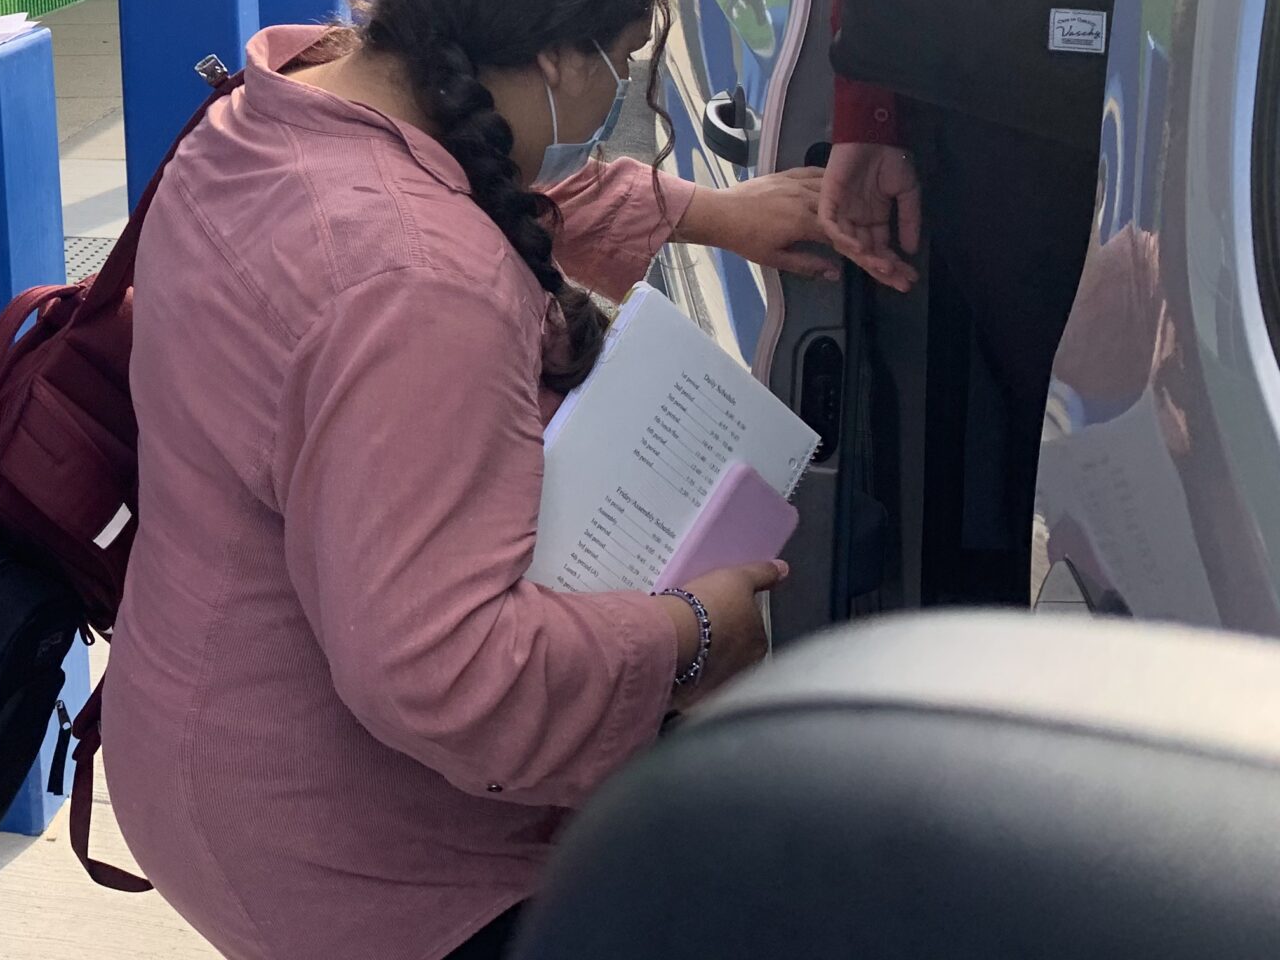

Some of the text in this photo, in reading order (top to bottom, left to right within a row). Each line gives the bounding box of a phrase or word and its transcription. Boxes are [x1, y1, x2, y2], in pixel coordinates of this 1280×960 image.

[704, 374, 737, 406] Daily Schedule
[610, 501, 625, 514] period
[616, 486, 677, 539] Friday Assembly Schedule
[598, 507, 618, 526] Assembly
[596, 524, 612, 537] period
[591, 537, 607, 550] period
[584, 547, 599, 561] period
[576, 559, 593, 572] period
